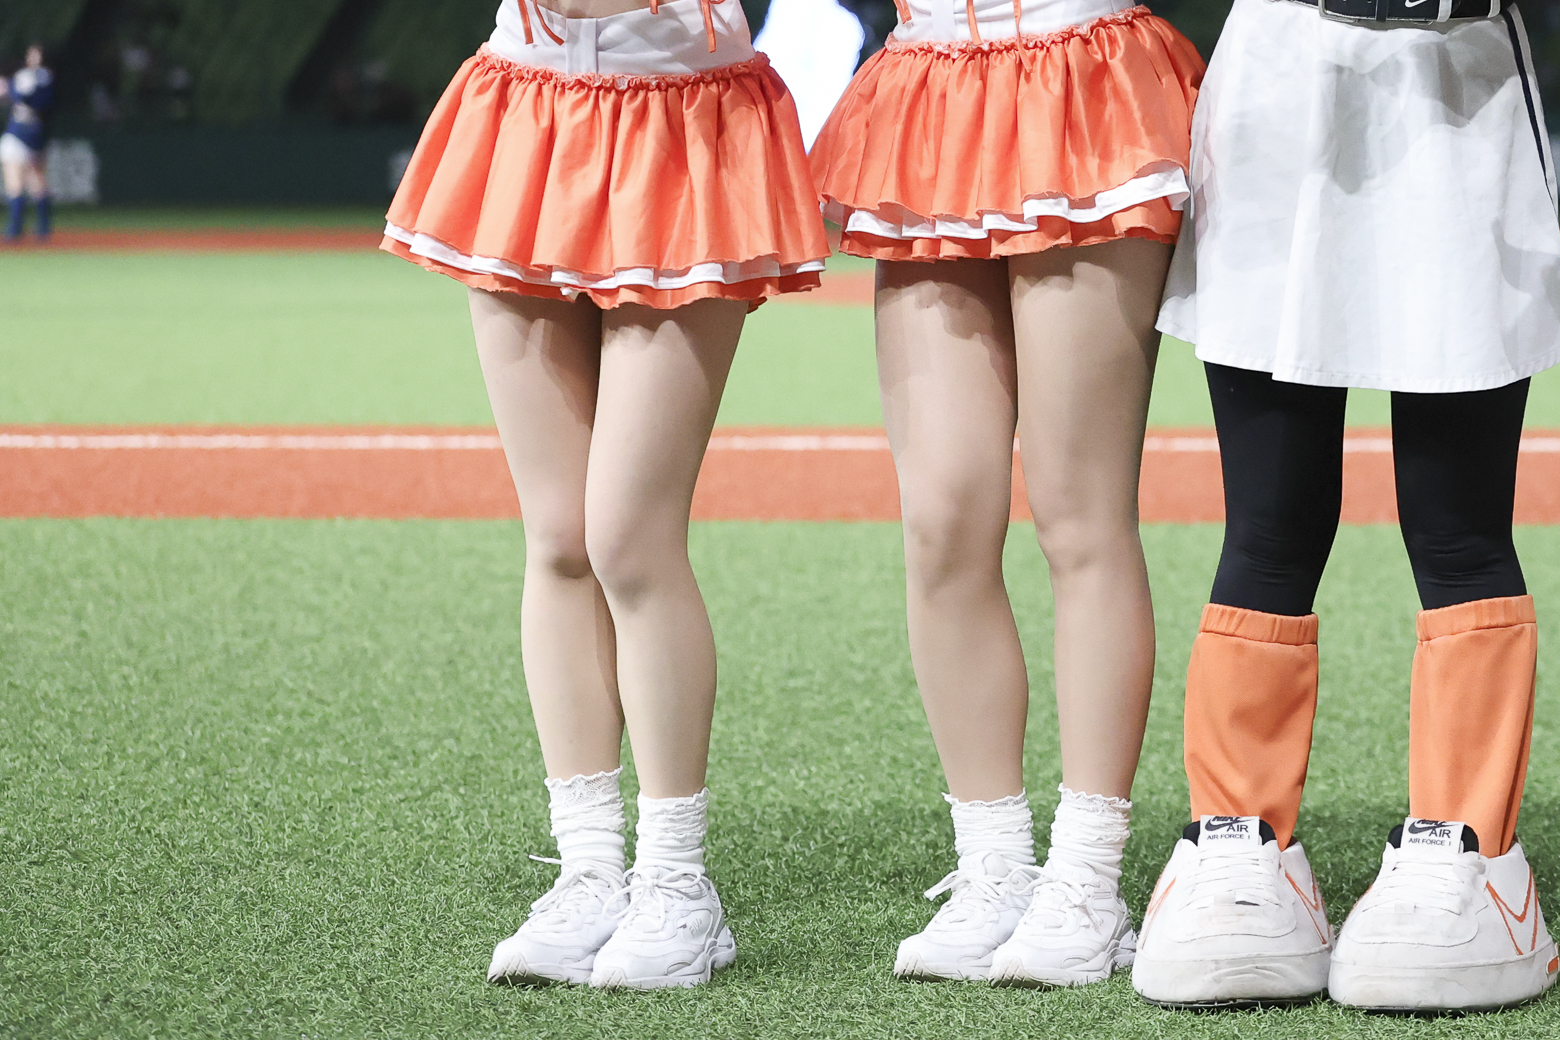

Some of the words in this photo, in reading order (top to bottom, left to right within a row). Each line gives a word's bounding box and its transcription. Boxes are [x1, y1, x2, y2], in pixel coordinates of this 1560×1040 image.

[1226, 824, 1249, 833] AIR
[1428, 828, 1452, 838] AIR
[1422, 838, 1446, 846] FORCE
